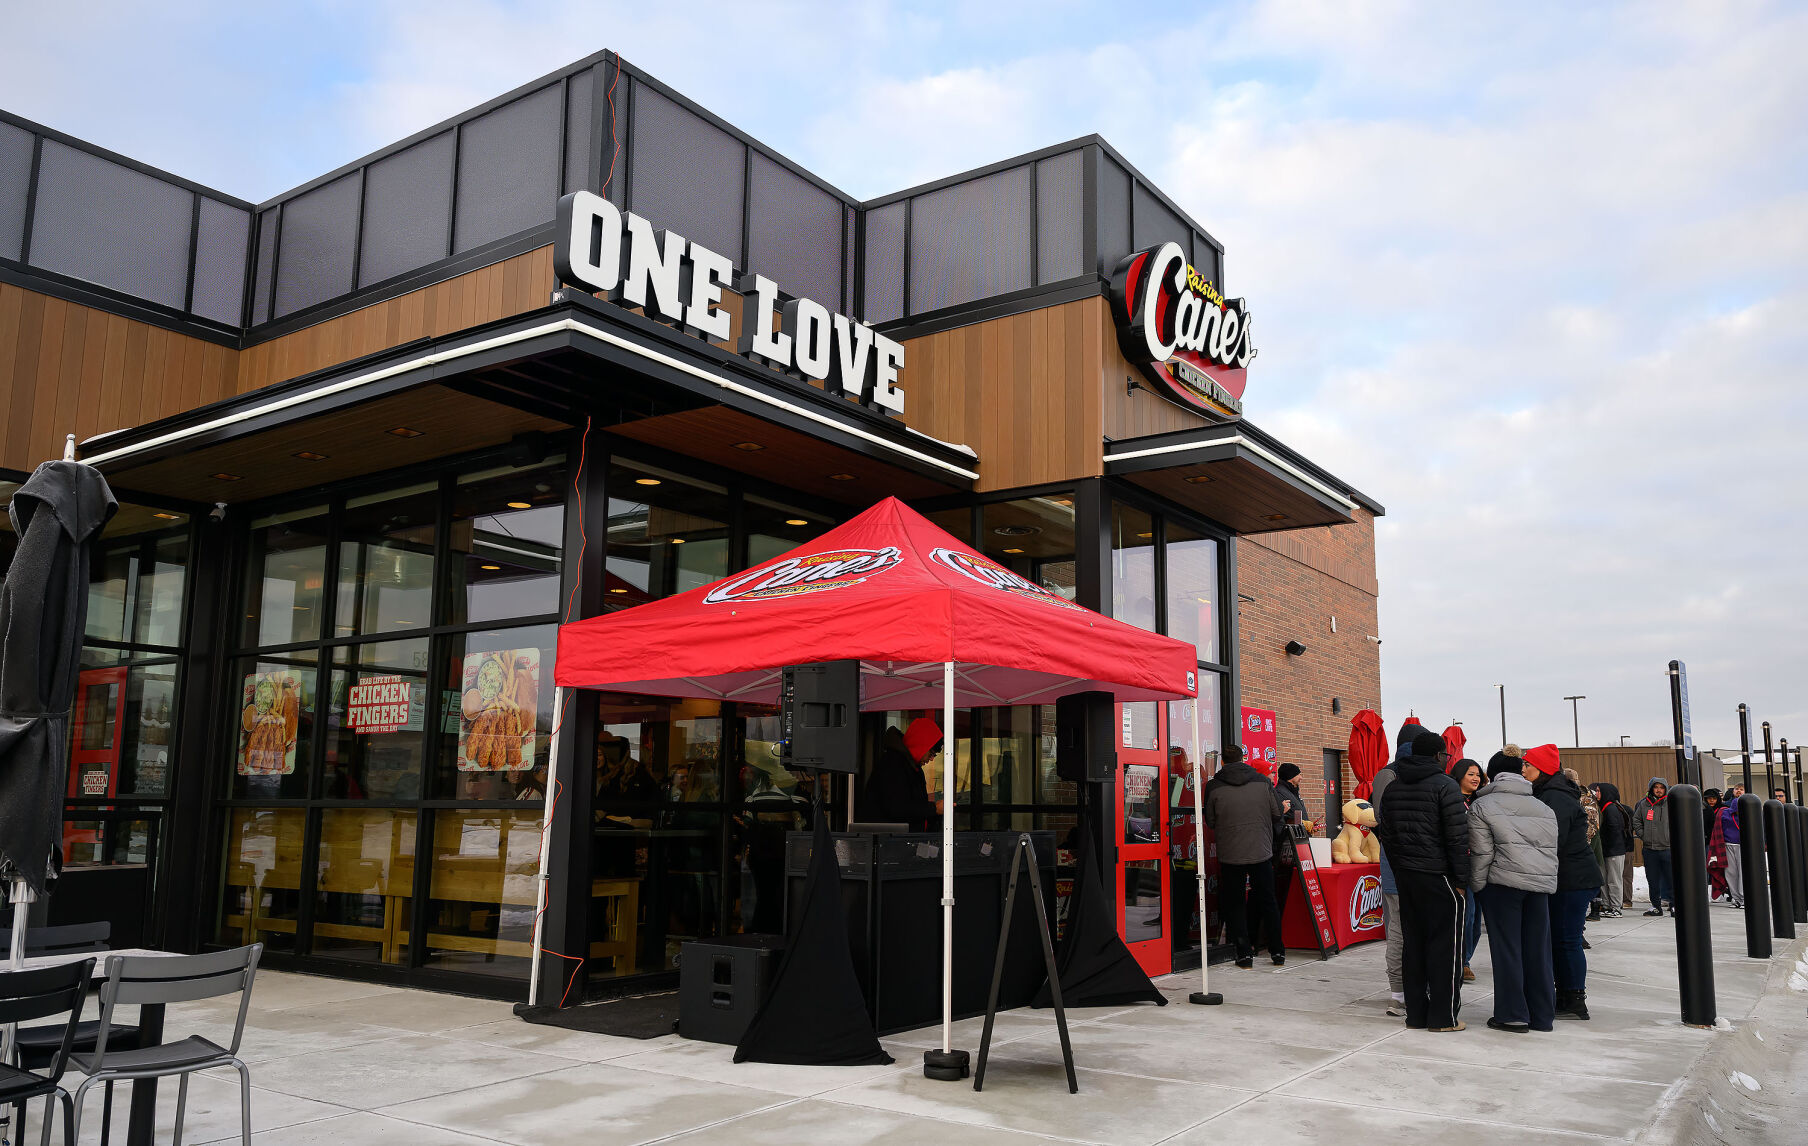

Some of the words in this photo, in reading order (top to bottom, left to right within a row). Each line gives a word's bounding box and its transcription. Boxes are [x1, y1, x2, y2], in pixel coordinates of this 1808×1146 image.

[1186, 264, 1224, 308] Raising
[568, 190, 734, 342] ONE
[751, 273, 905, 415] LOVE
[1144, 241, 1258, 369] Cane's
[706, 547, 902, 602] Cane's
[350, 683, 410, 705] CHICKEN
[348, 704, 408, 726] FINGERS
[84, 775, 107, 785] CHICKEN
[85, 785, 104, 793] FINGERS
[1126, 775, 1152, 788] CHICKEN
[1129, 786, 1149, 797] FINGERS
